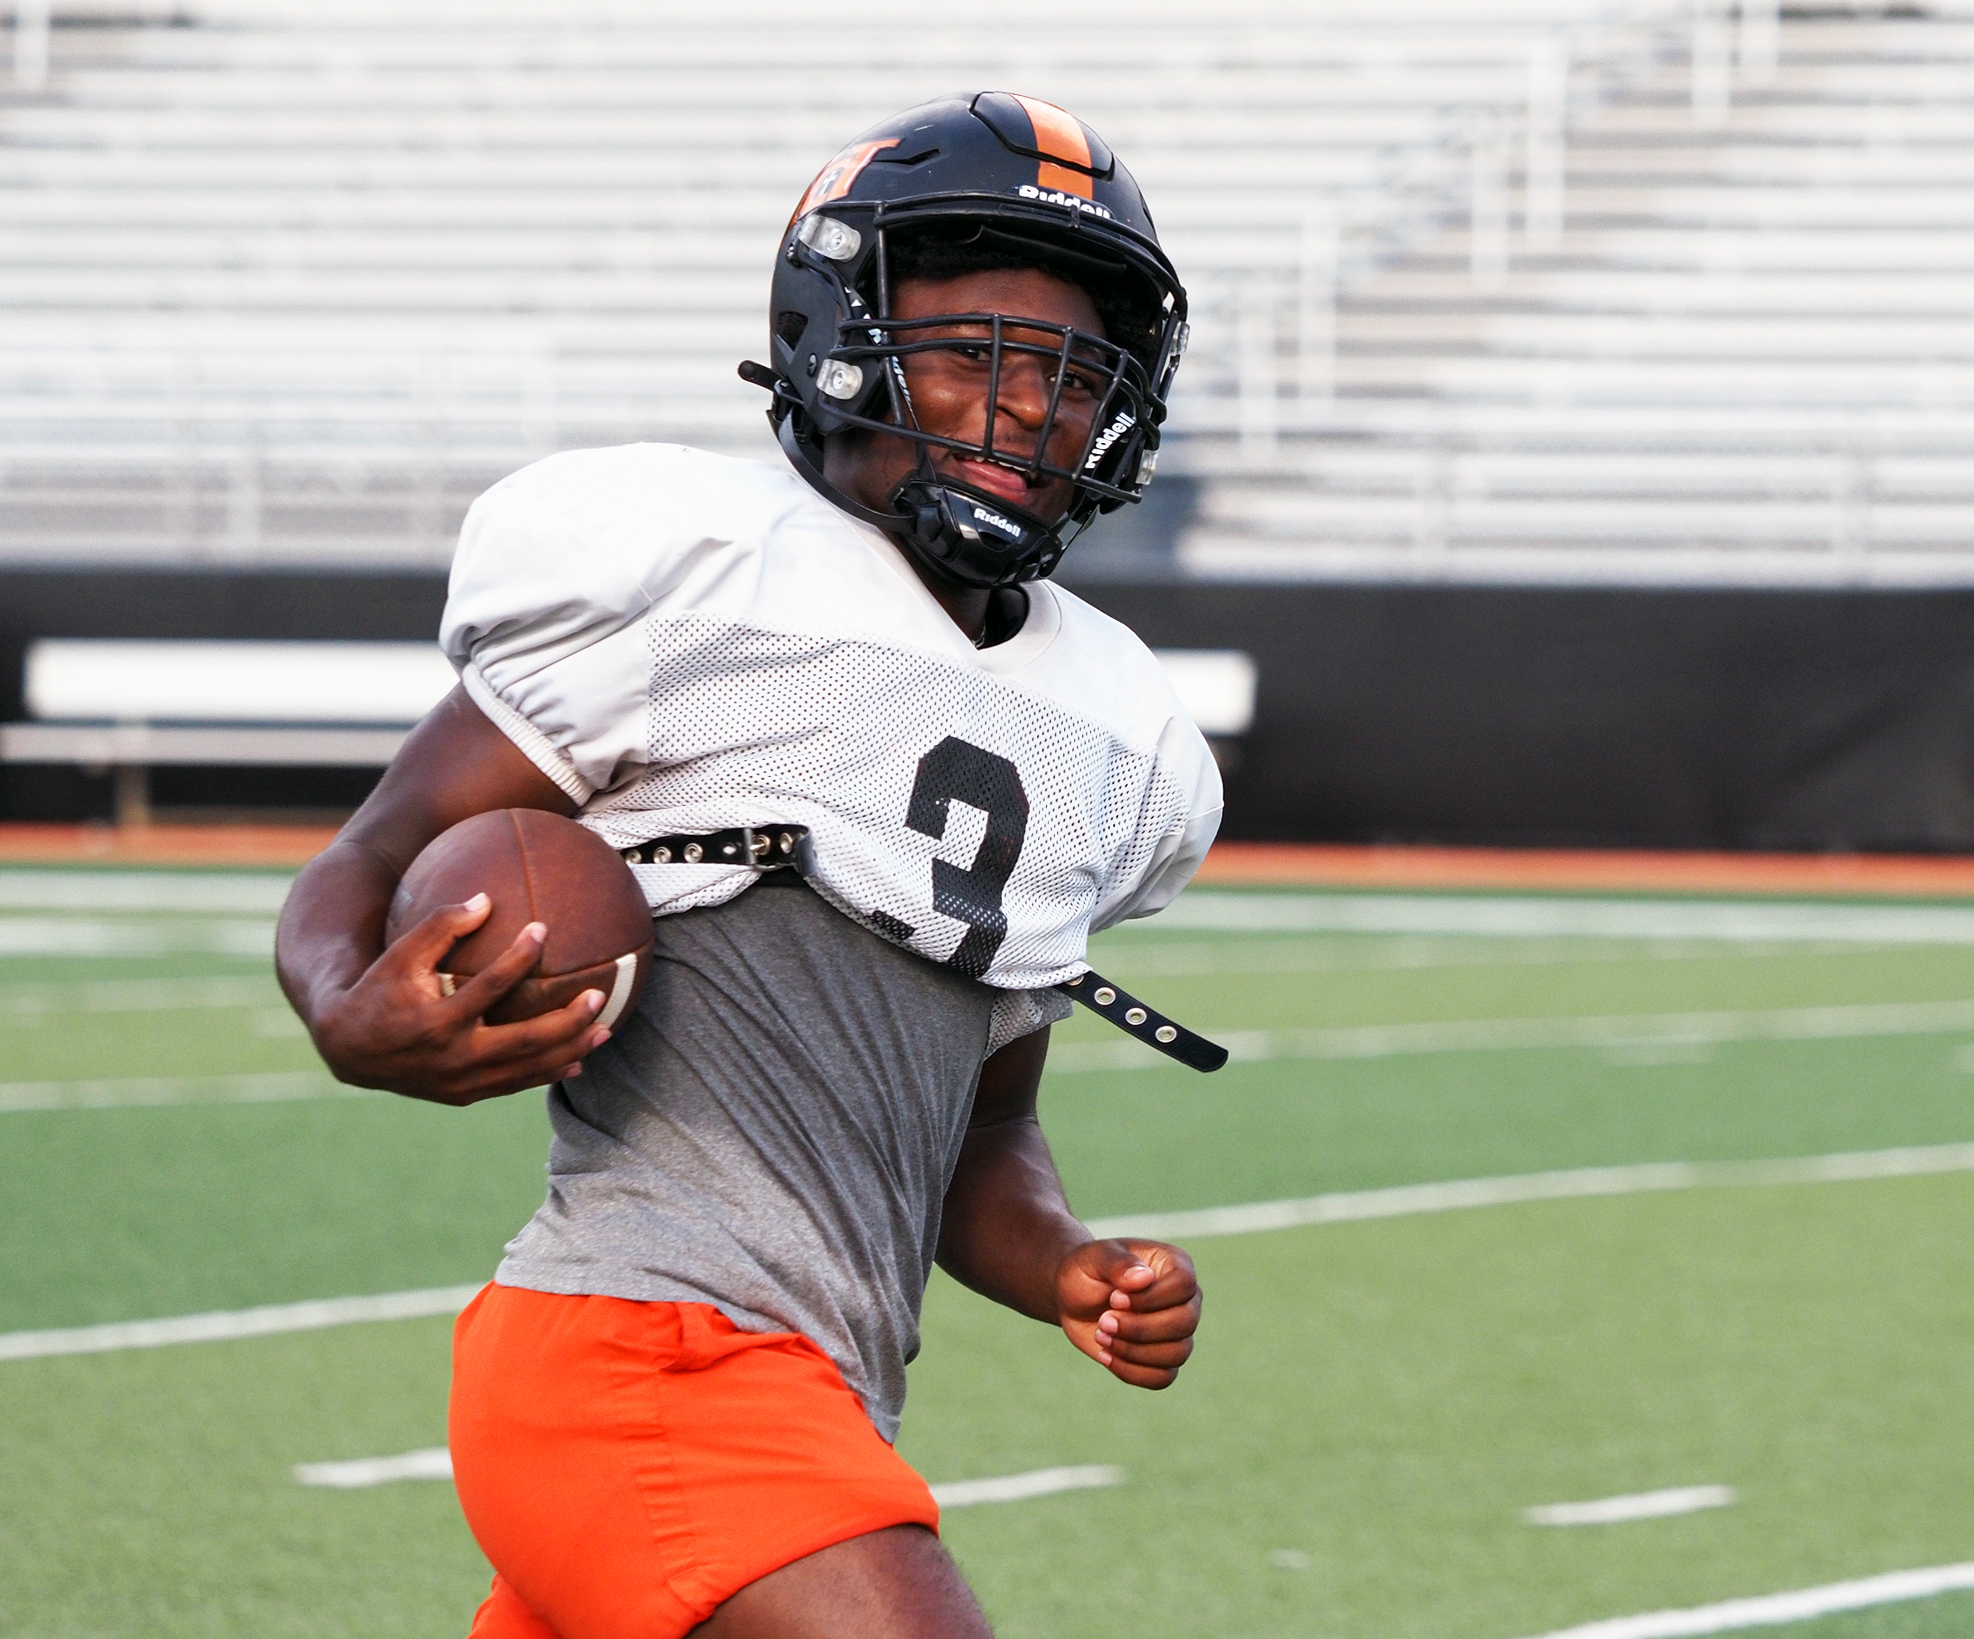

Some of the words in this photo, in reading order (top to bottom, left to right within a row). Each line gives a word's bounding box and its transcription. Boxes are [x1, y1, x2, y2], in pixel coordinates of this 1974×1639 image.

[1084, 412, 1135, 469] Riddell
[973, 507, 1021, 537] Riddell
[872, 735, 1030, 979] 3
